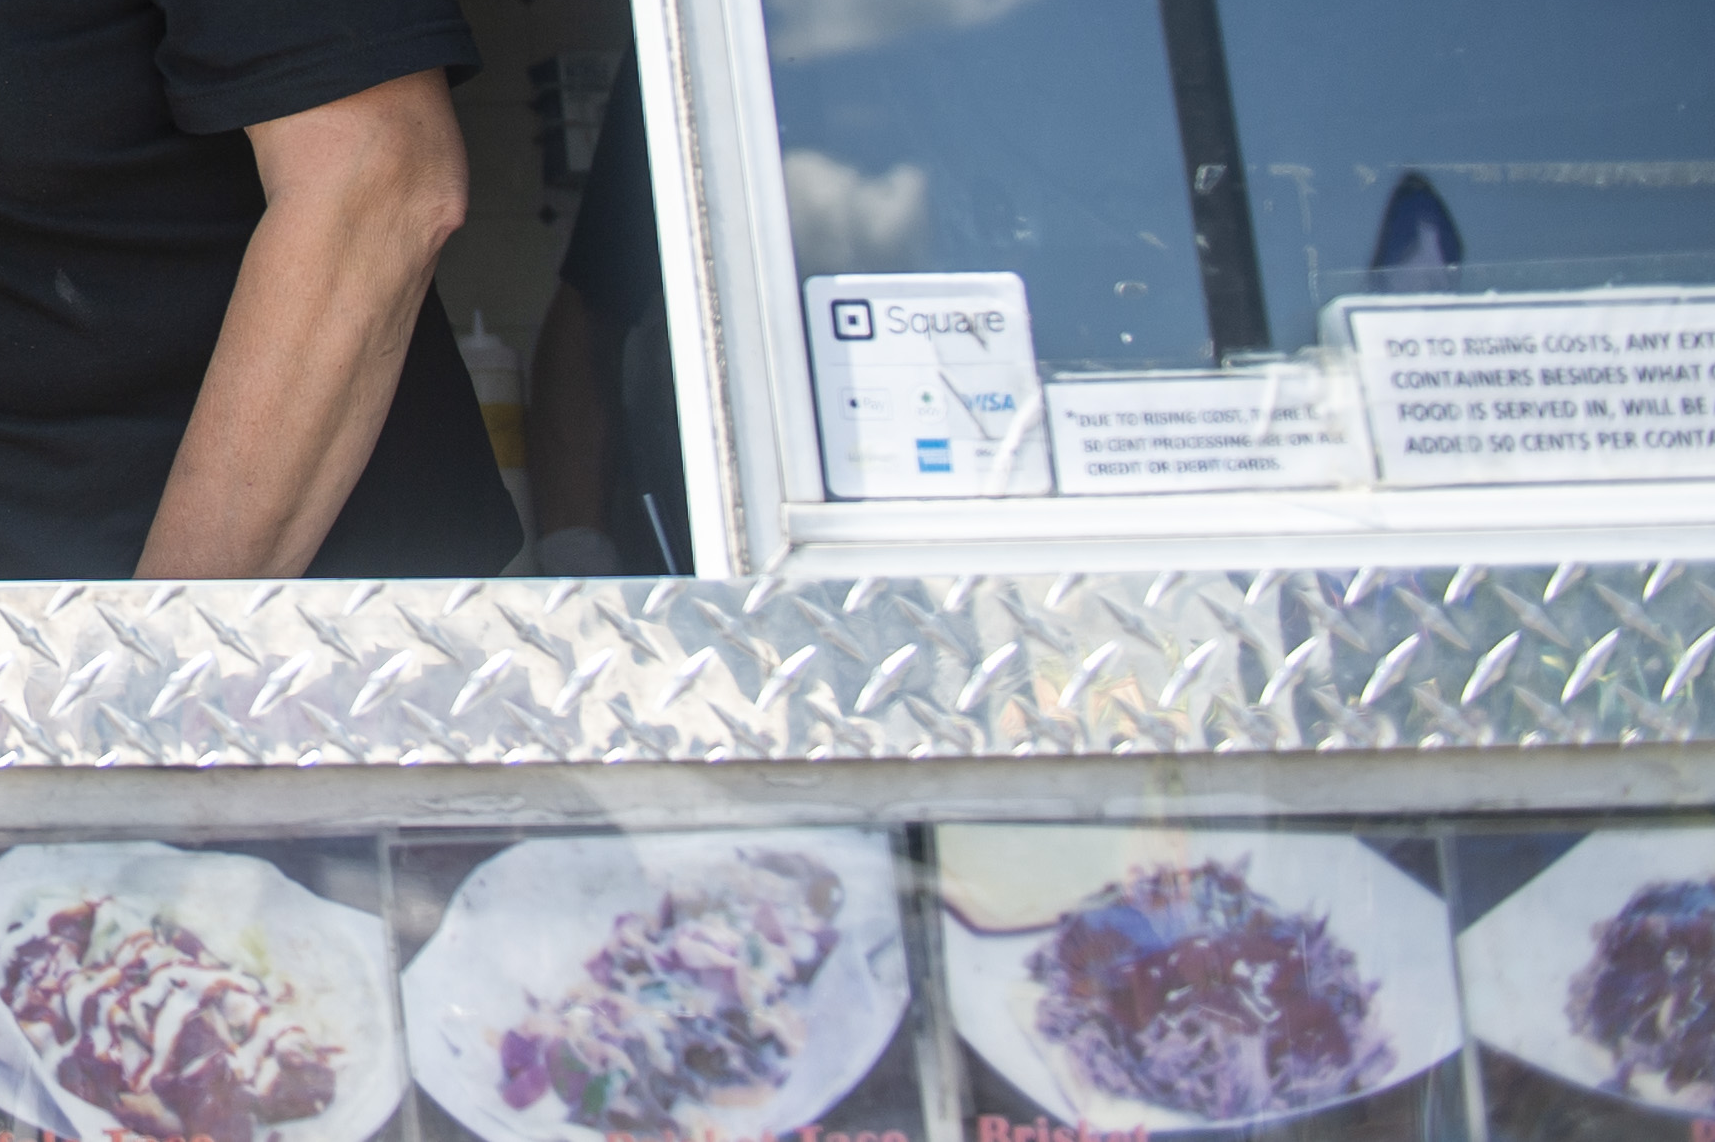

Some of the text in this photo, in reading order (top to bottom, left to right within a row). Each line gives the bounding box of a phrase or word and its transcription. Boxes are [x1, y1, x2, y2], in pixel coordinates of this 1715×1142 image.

[887, 305, 1005, 341] Square
[1386, 338, 1421, 357] DO
[1426, 337, 1457, 356] TO
[1462, 335, 1537, 355] RISING
[1542, 334, 1620, 355] COSTS,
[1626, 332, 1671, 352] ANY
[1391, 368, 1533, 390] CONTAINERS
[1539, 366, 1628, 387] BESIDES
[1634, 364, 1702, 384] WHAT
[1116, 411, 1138, 427] TO
[1143, 410, 1196, 426] RISING
[1250, 407, 1301, 424] TERE
[1398, 396, 1708, 422] FOOD IS SERVED IN, WILL BE
[1083, 438, 1104, 453] 50
[1107, 438, 1147, 453] CENT
[1152, 435, 1252, 452] PROCESSING
[1288, 431, 1314, 446] ON
[1404, 435, 1482, 455] ADDED
[1489, 434, 1515, 453] 50
[1520, 431, 1590, 452] CENTS
[1597, 430, 1636, 450] PER
[1087, 460, 1142, 476] CREDIT
[1148, 460, 1172, 474] OR
[1176, 458, 1223, 474] DEBIT
